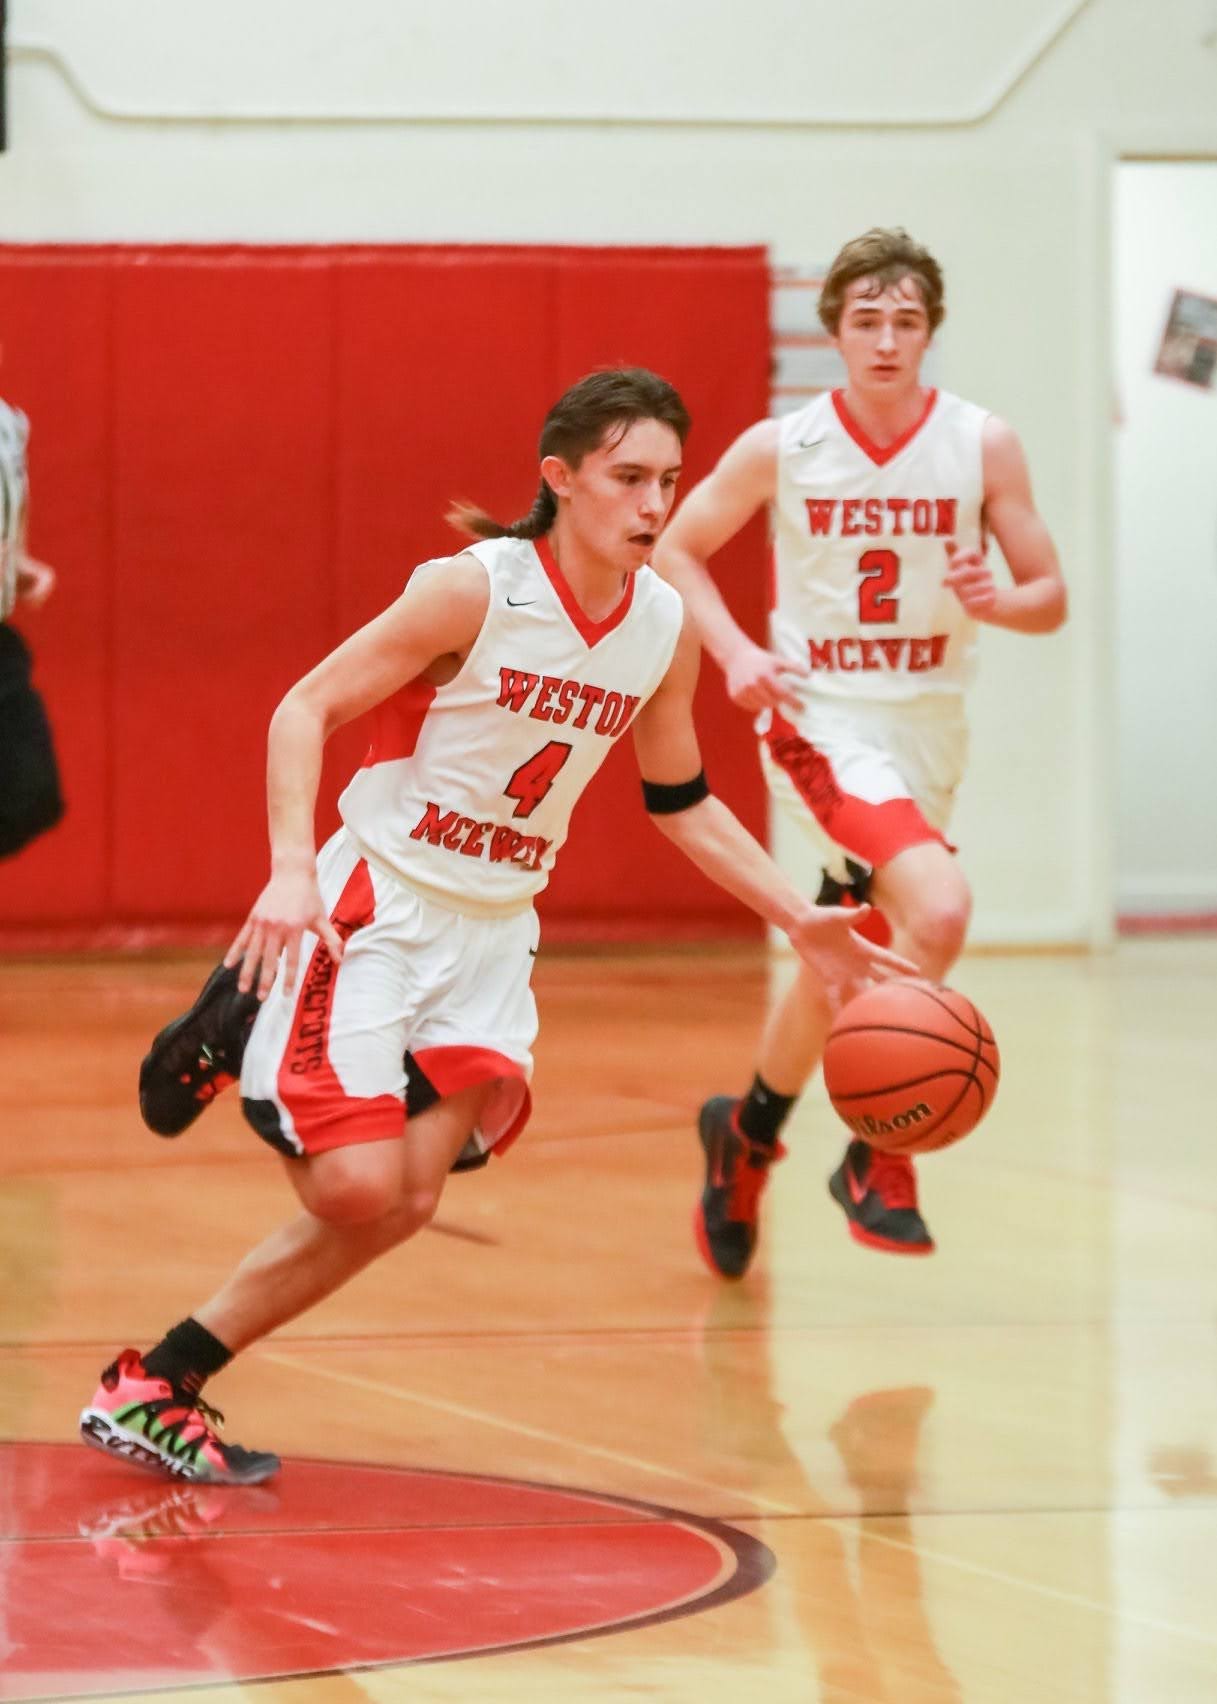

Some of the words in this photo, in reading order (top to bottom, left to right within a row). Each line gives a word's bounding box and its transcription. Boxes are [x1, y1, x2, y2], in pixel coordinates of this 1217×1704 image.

[806, 498, 957, 536] WESTON
[858, 549, 900, 623] 2
[496, 667, 641, 737] WESTON
[503, 740, 573, 818] 4
